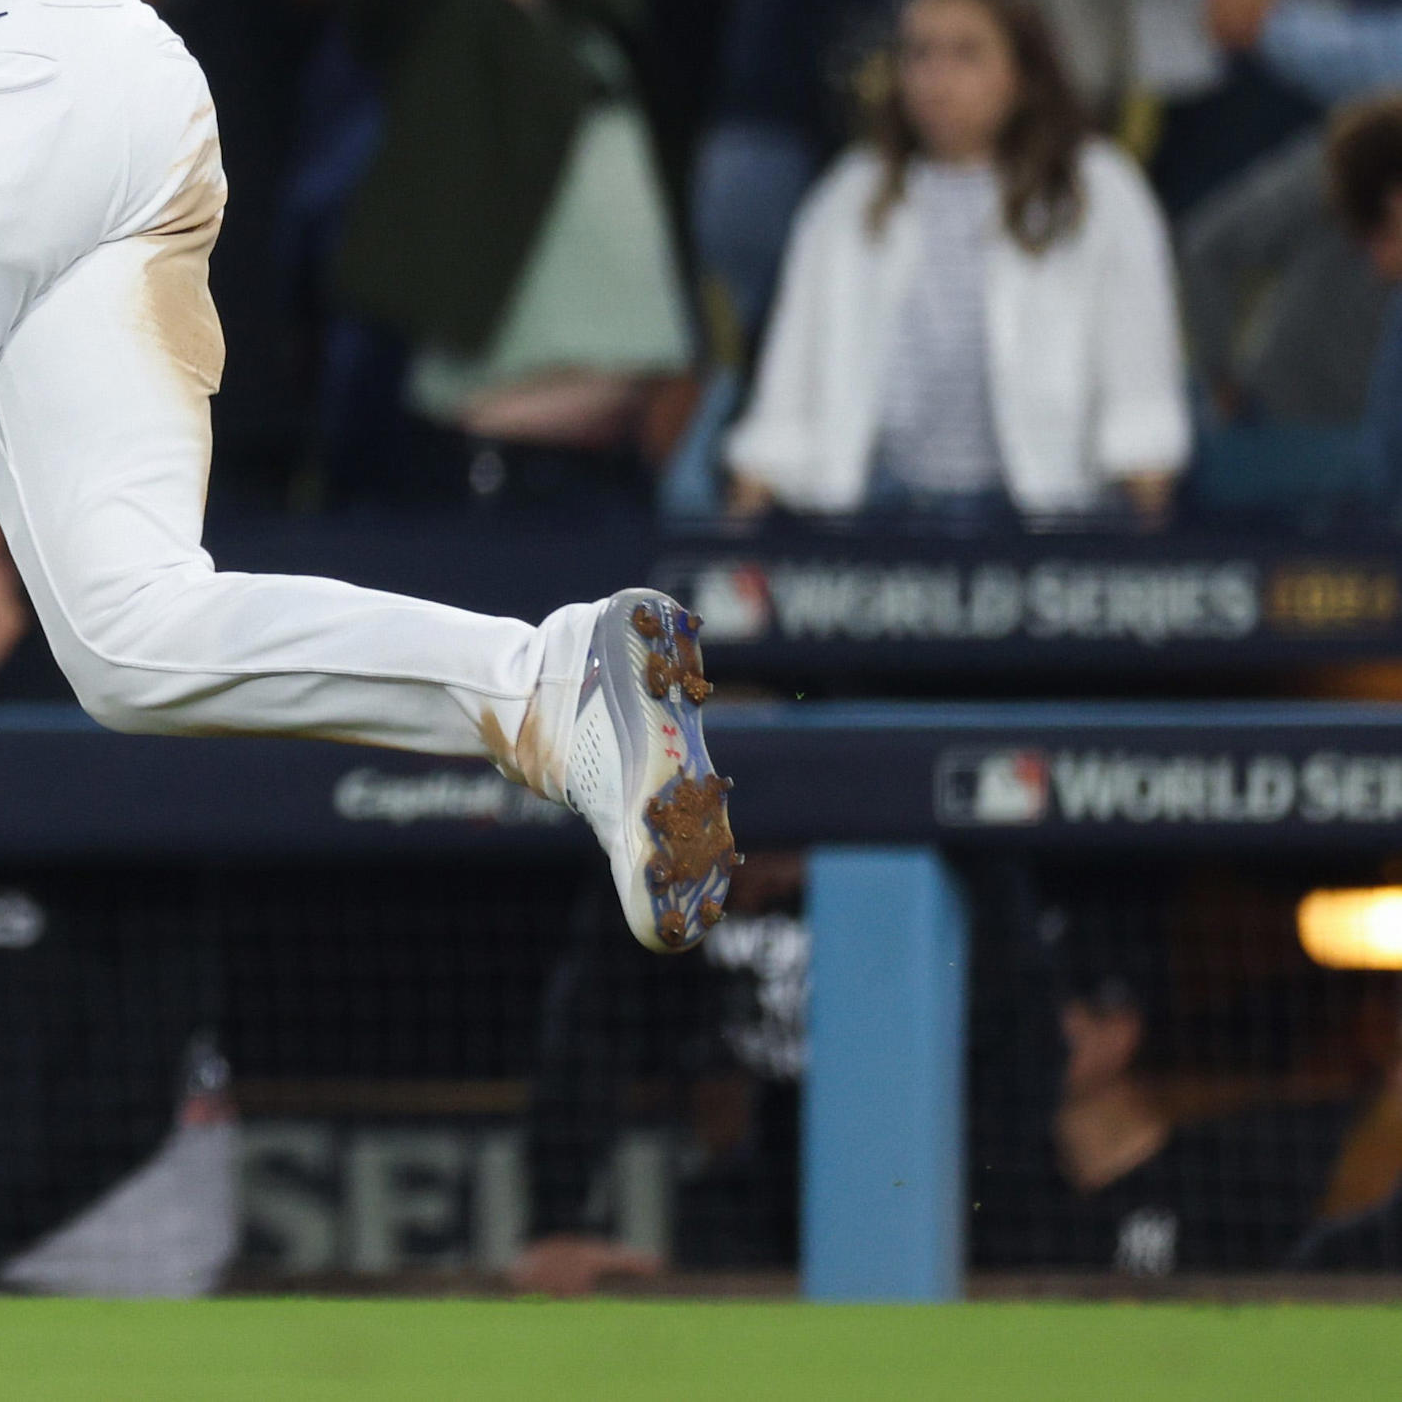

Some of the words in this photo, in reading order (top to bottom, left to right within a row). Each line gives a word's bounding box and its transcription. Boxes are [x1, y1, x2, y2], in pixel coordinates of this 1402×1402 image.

[774, 560, 1023, 639] WORLD
[1025, 560, 1258, 645] SERIES
[1053, 753, 1295, 823] WORLD
